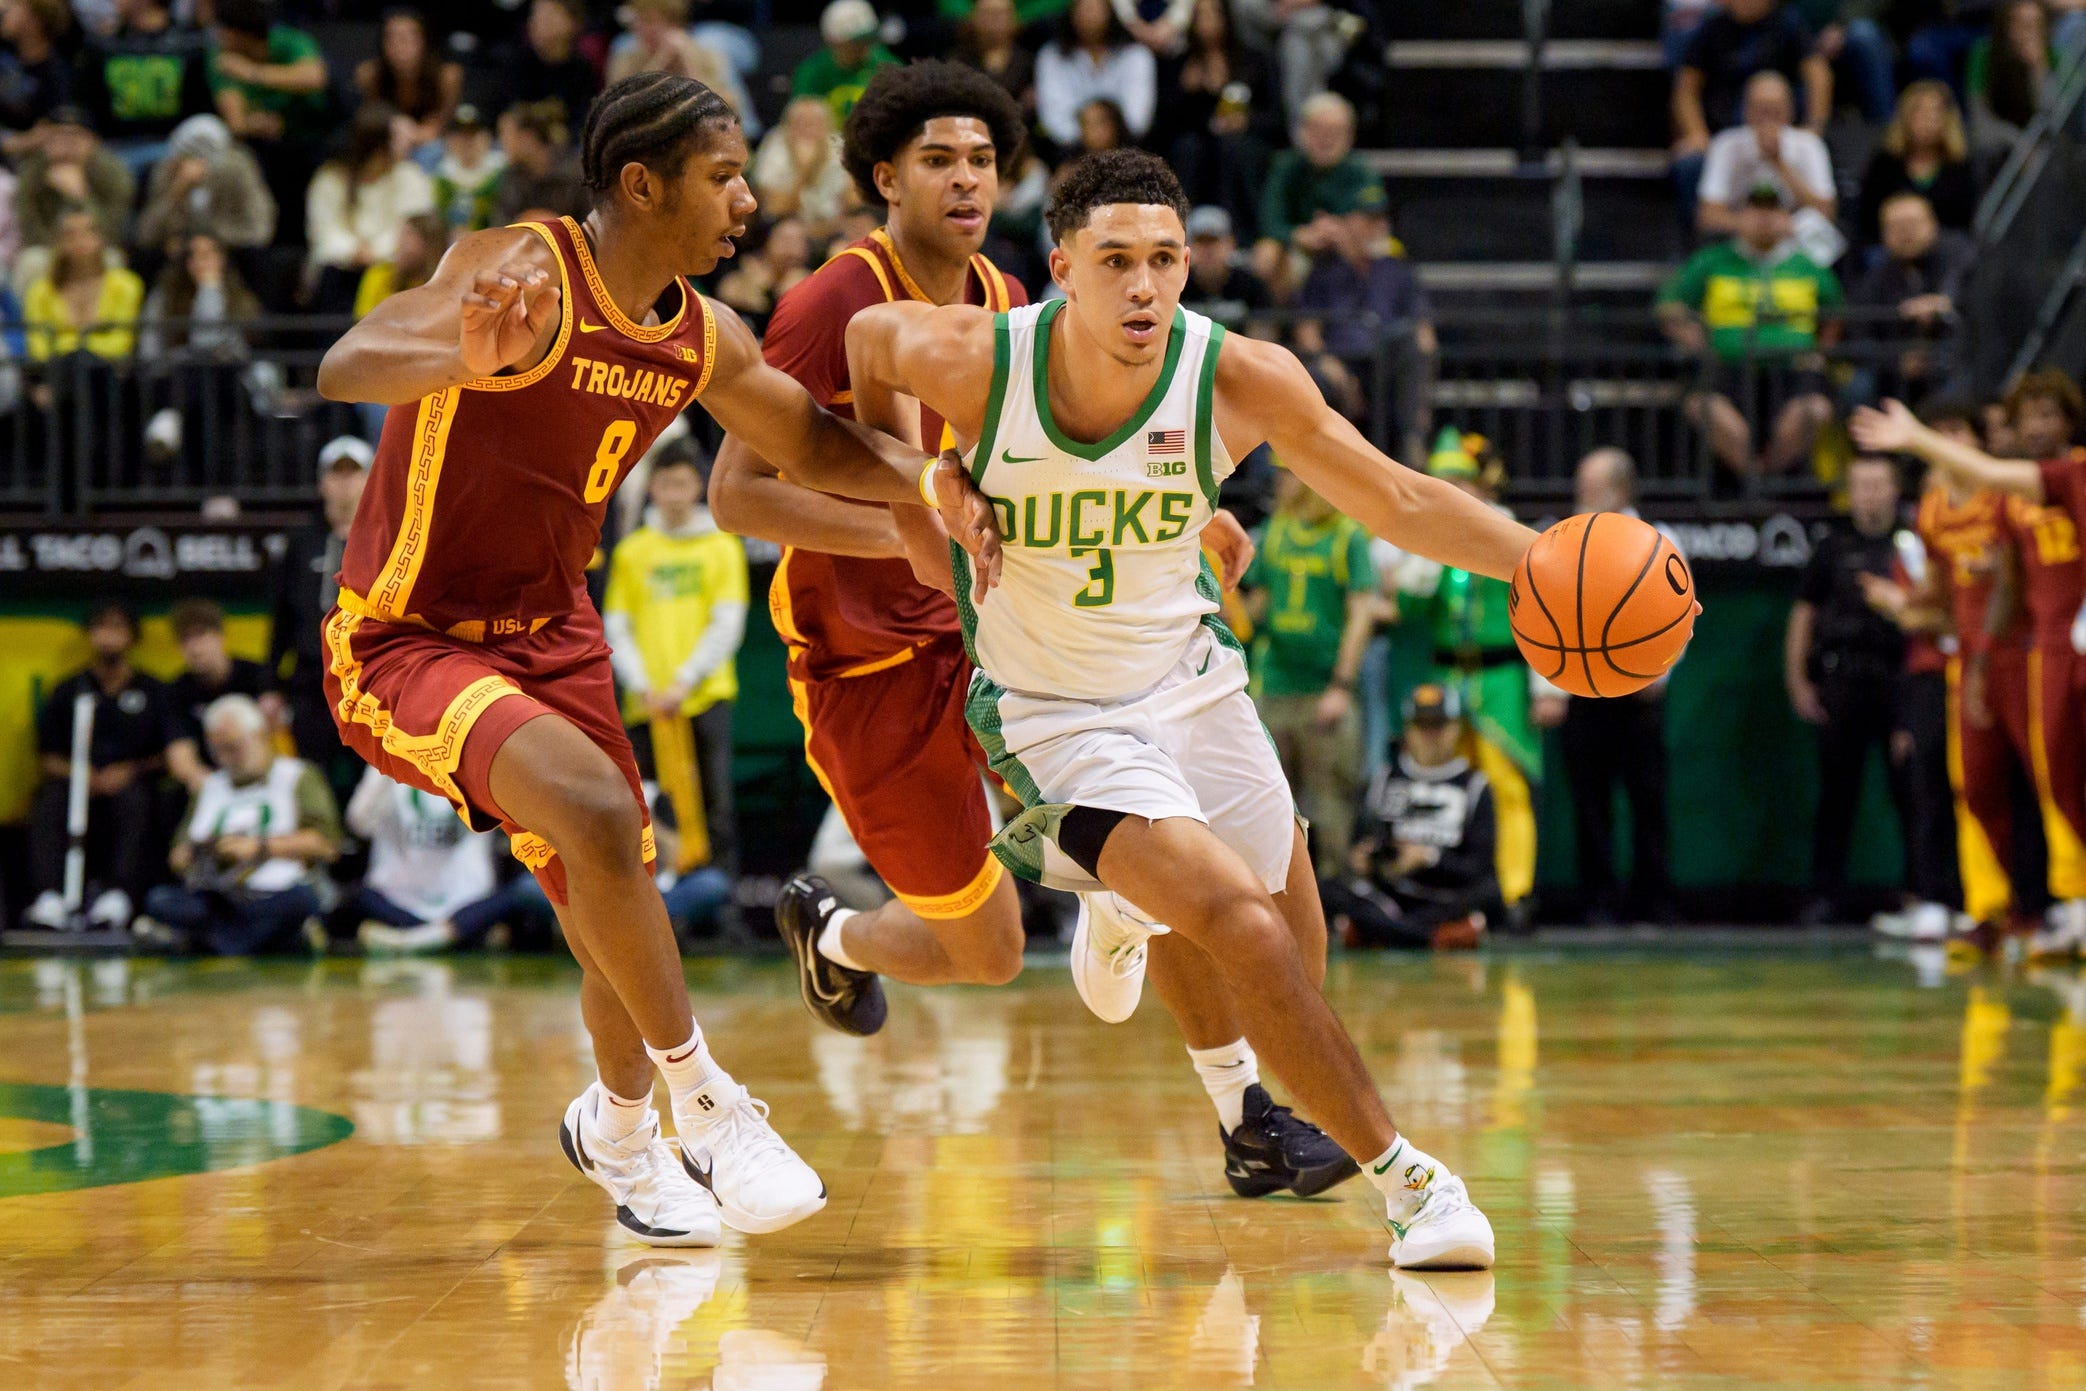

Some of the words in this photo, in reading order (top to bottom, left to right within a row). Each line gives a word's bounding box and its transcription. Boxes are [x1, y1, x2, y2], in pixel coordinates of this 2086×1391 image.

[571, 357, 689, 408] TROJANS
[584, 419, 637, 504] 8
[31, 533, 122, 571] TACO
[175, 533, 262, 571] BELL
[1069, 547, 1116, 607] 3
